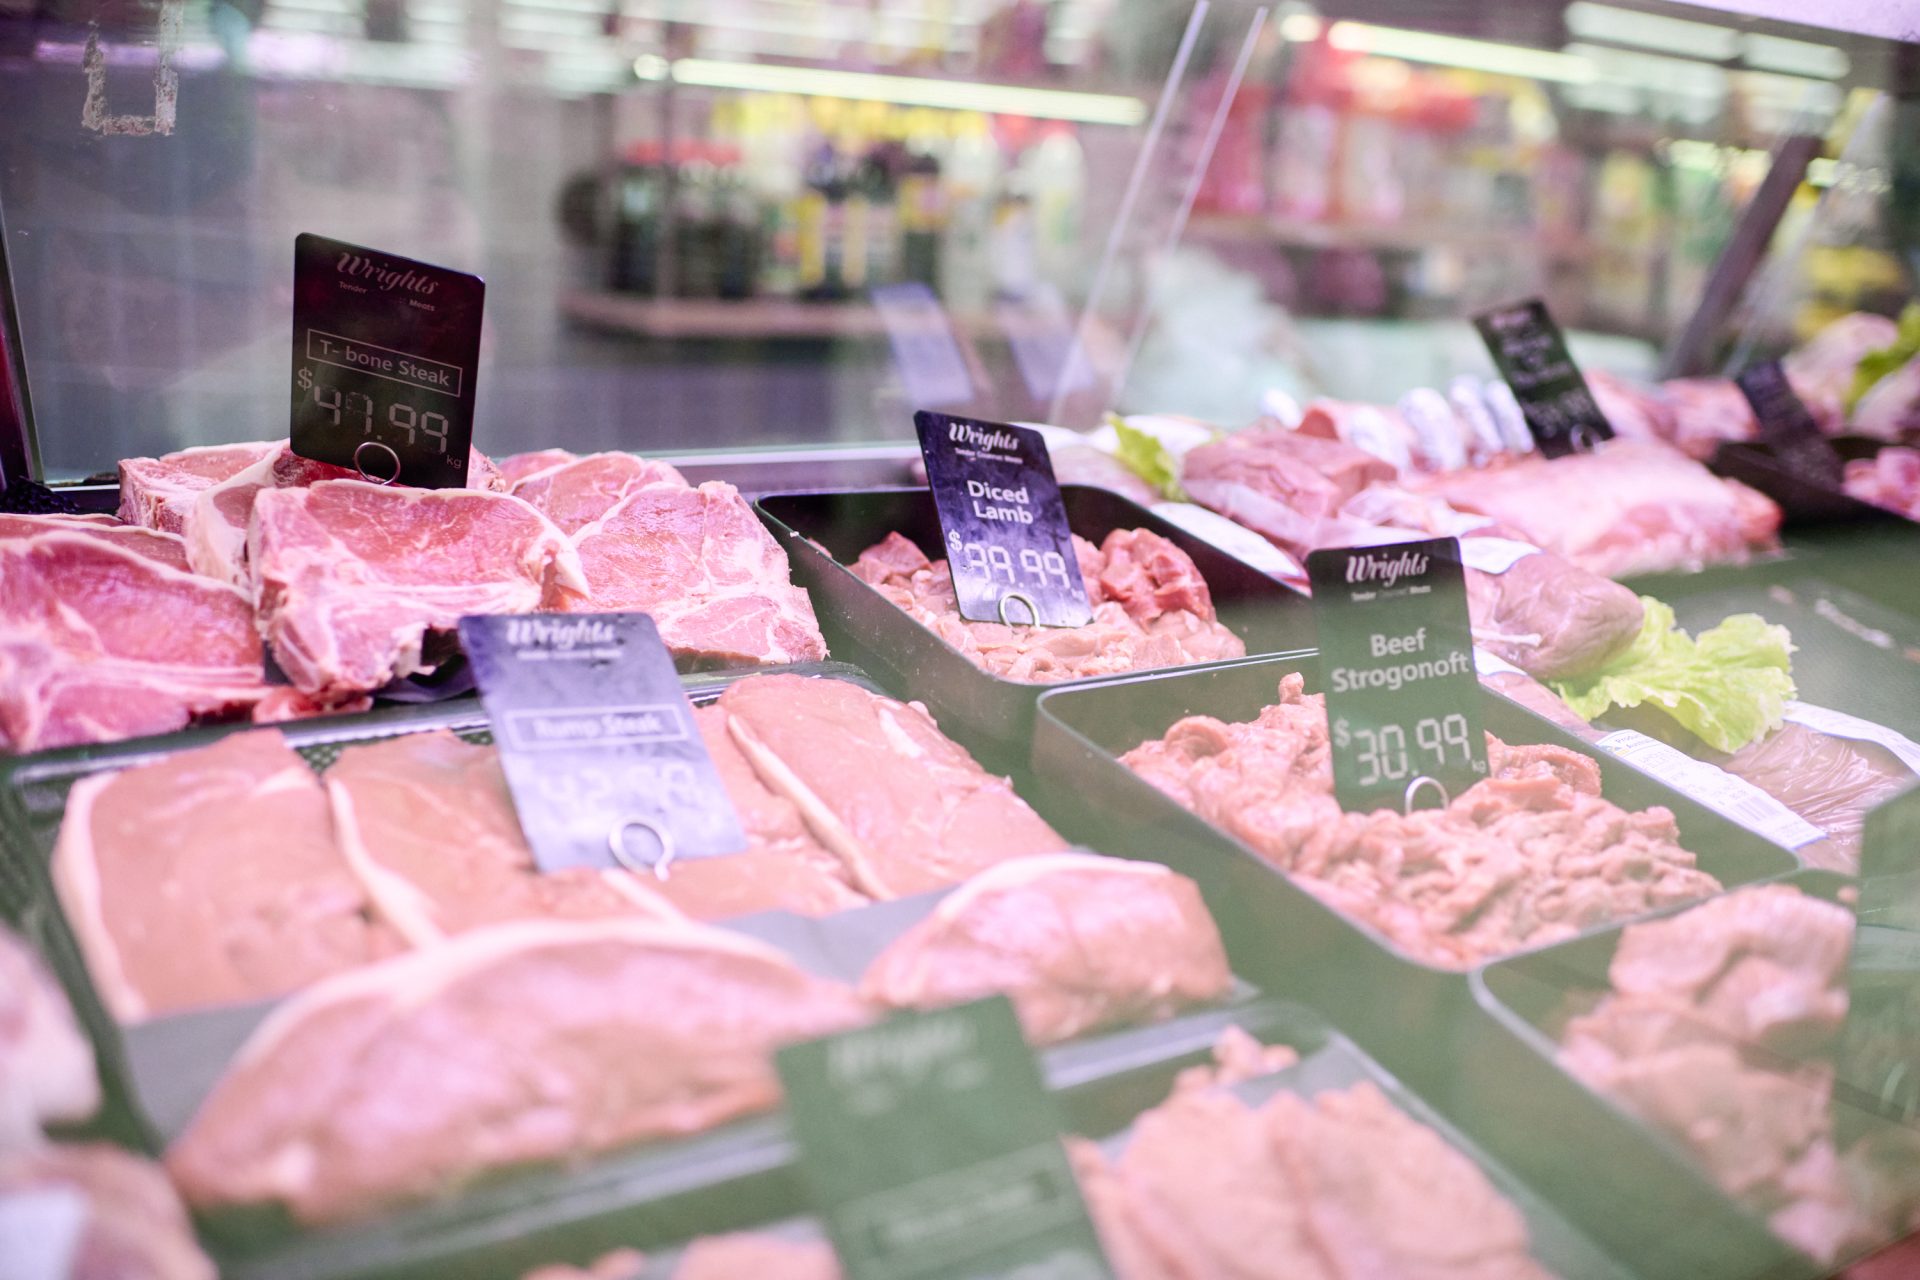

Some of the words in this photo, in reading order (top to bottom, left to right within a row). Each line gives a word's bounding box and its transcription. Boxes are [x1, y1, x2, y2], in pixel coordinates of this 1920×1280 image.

[336, 252, 439, 296] Wrights
[398, 361, 450, 386] Steak
[948, 422, 1020, 452] Wrights
[446, 454, 462, 469] kg
[967, 480, 1030, 505] Diced
[972, 501, 1034, 525] Lamb
[1345, 551, 1430, 587] Wrights
[1370, 627, 1427, 657] Beef
[1331, 651, 1470, 692] Strogonoft
